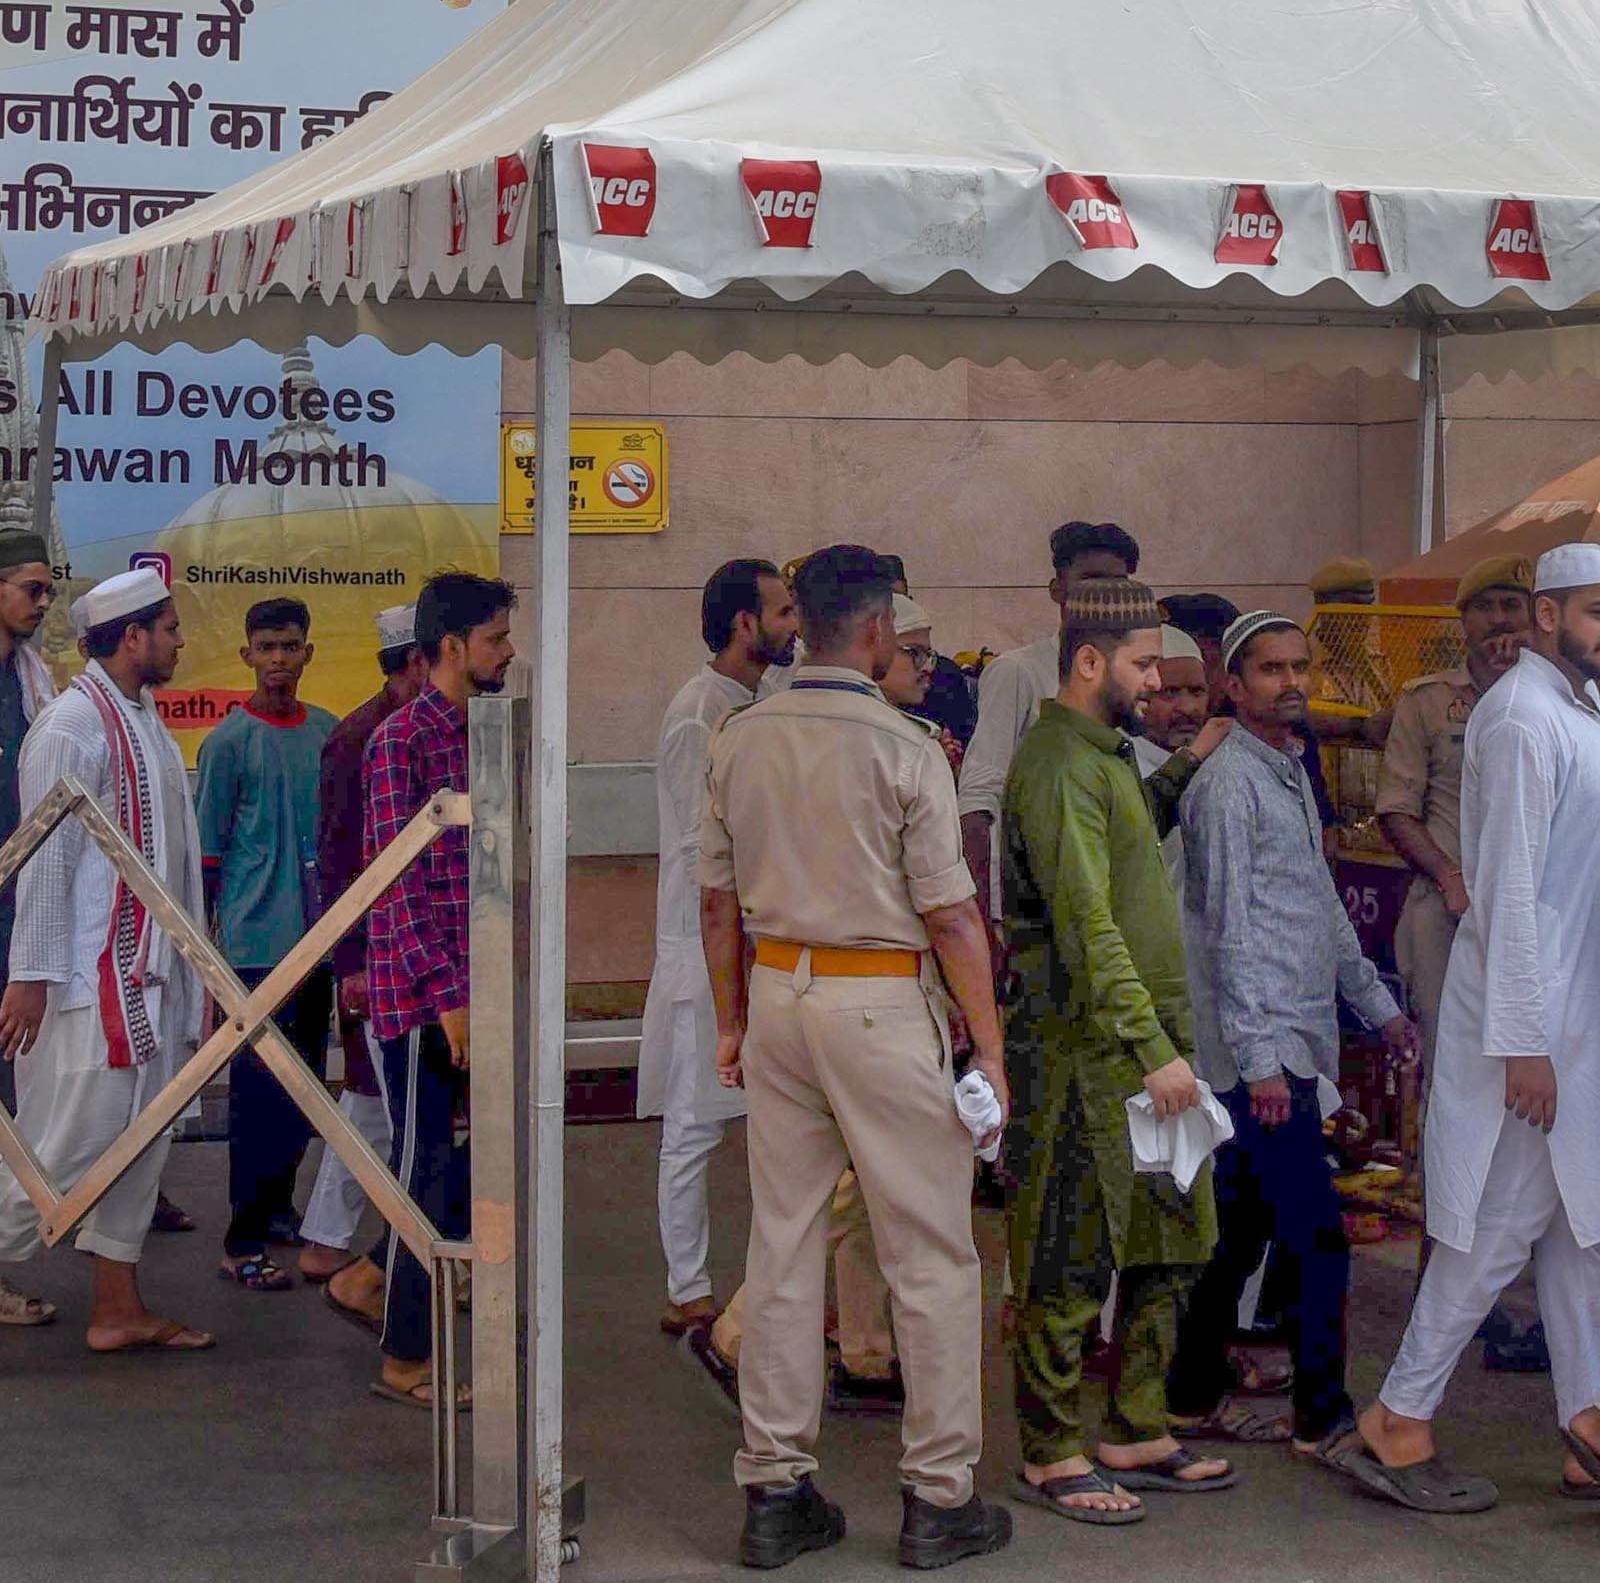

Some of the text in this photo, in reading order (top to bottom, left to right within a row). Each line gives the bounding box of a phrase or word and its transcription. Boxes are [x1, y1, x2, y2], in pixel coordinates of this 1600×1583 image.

[65, 5, 183, 58] मास
[209, 102, 287, 152] का
[591, 176, 650, 208] ACC
[754, 190, 818, 219] ACC
[1067, 198, 1122, 225] ACC
[1225, 213, 1277, 240] ACC
[137, 370, 397, 423] Devotees
[213, 438, 387, 488] Month
[186, 565, 406, 587] ShriKashiVishwanath
